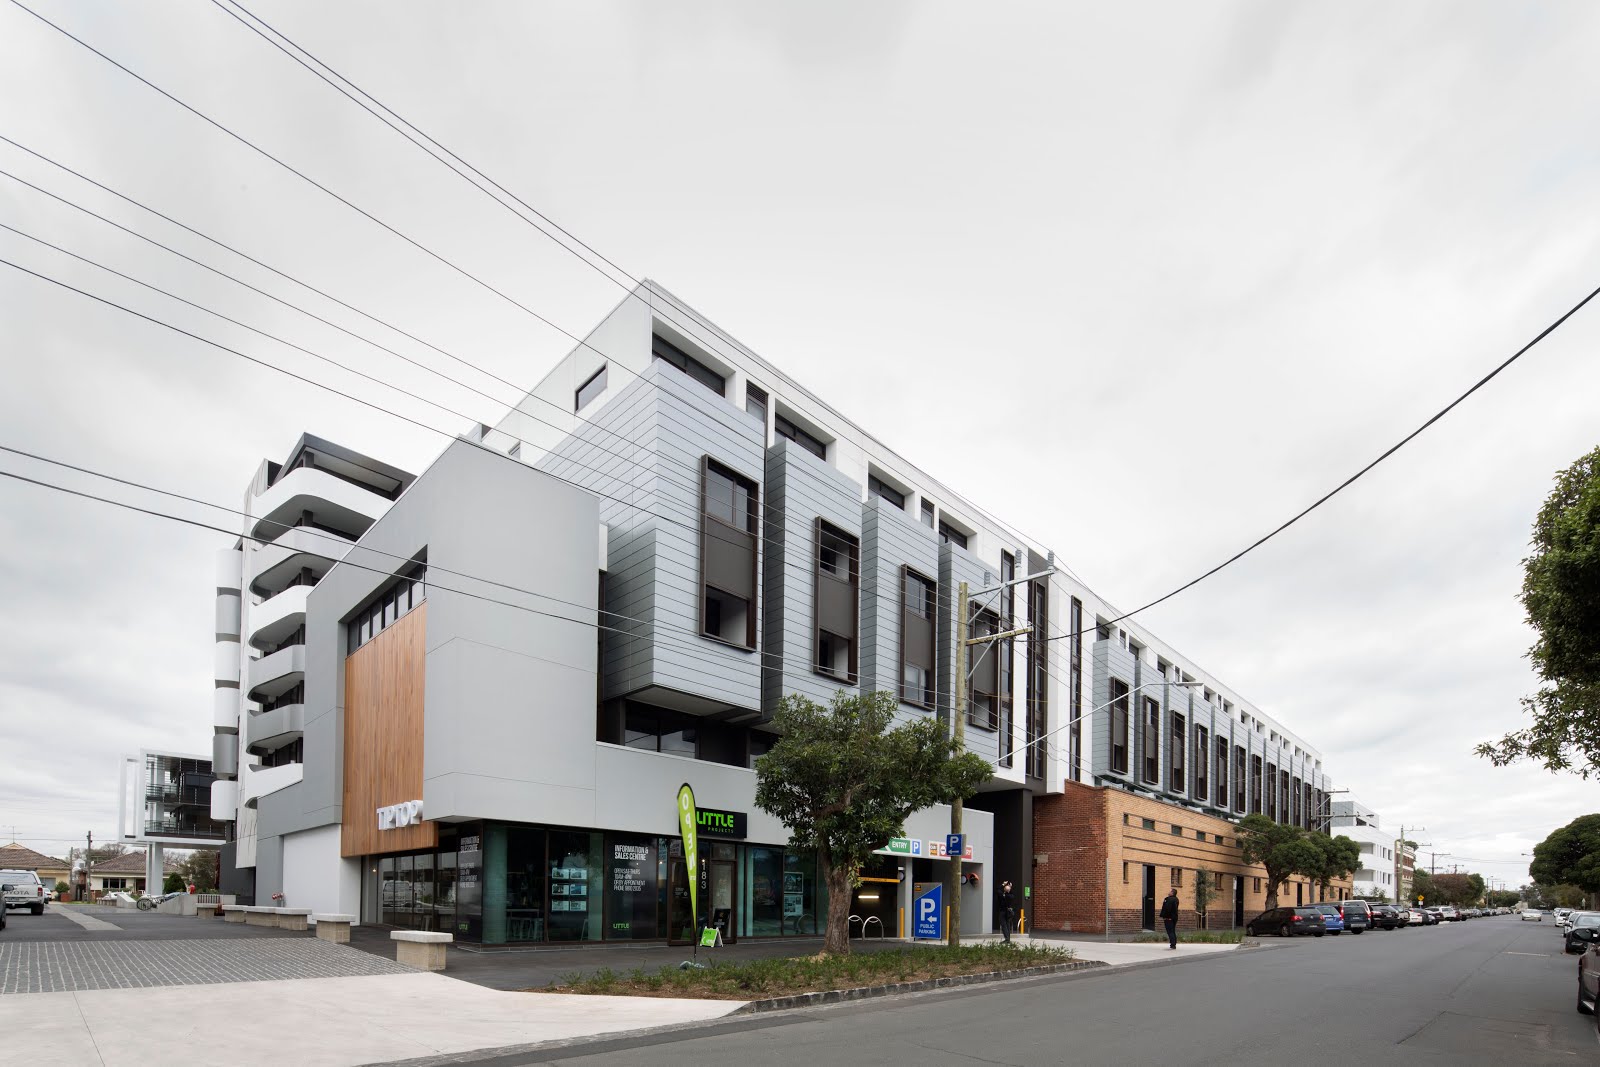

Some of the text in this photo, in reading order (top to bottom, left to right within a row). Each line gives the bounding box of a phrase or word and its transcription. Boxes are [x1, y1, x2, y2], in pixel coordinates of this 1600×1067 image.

[696, 811, 734, 828] LITTLE
[614, 844, 644, 854] INFORMATION
[950, 836, 959, 848] P
[920, 898, 936, 921] P
